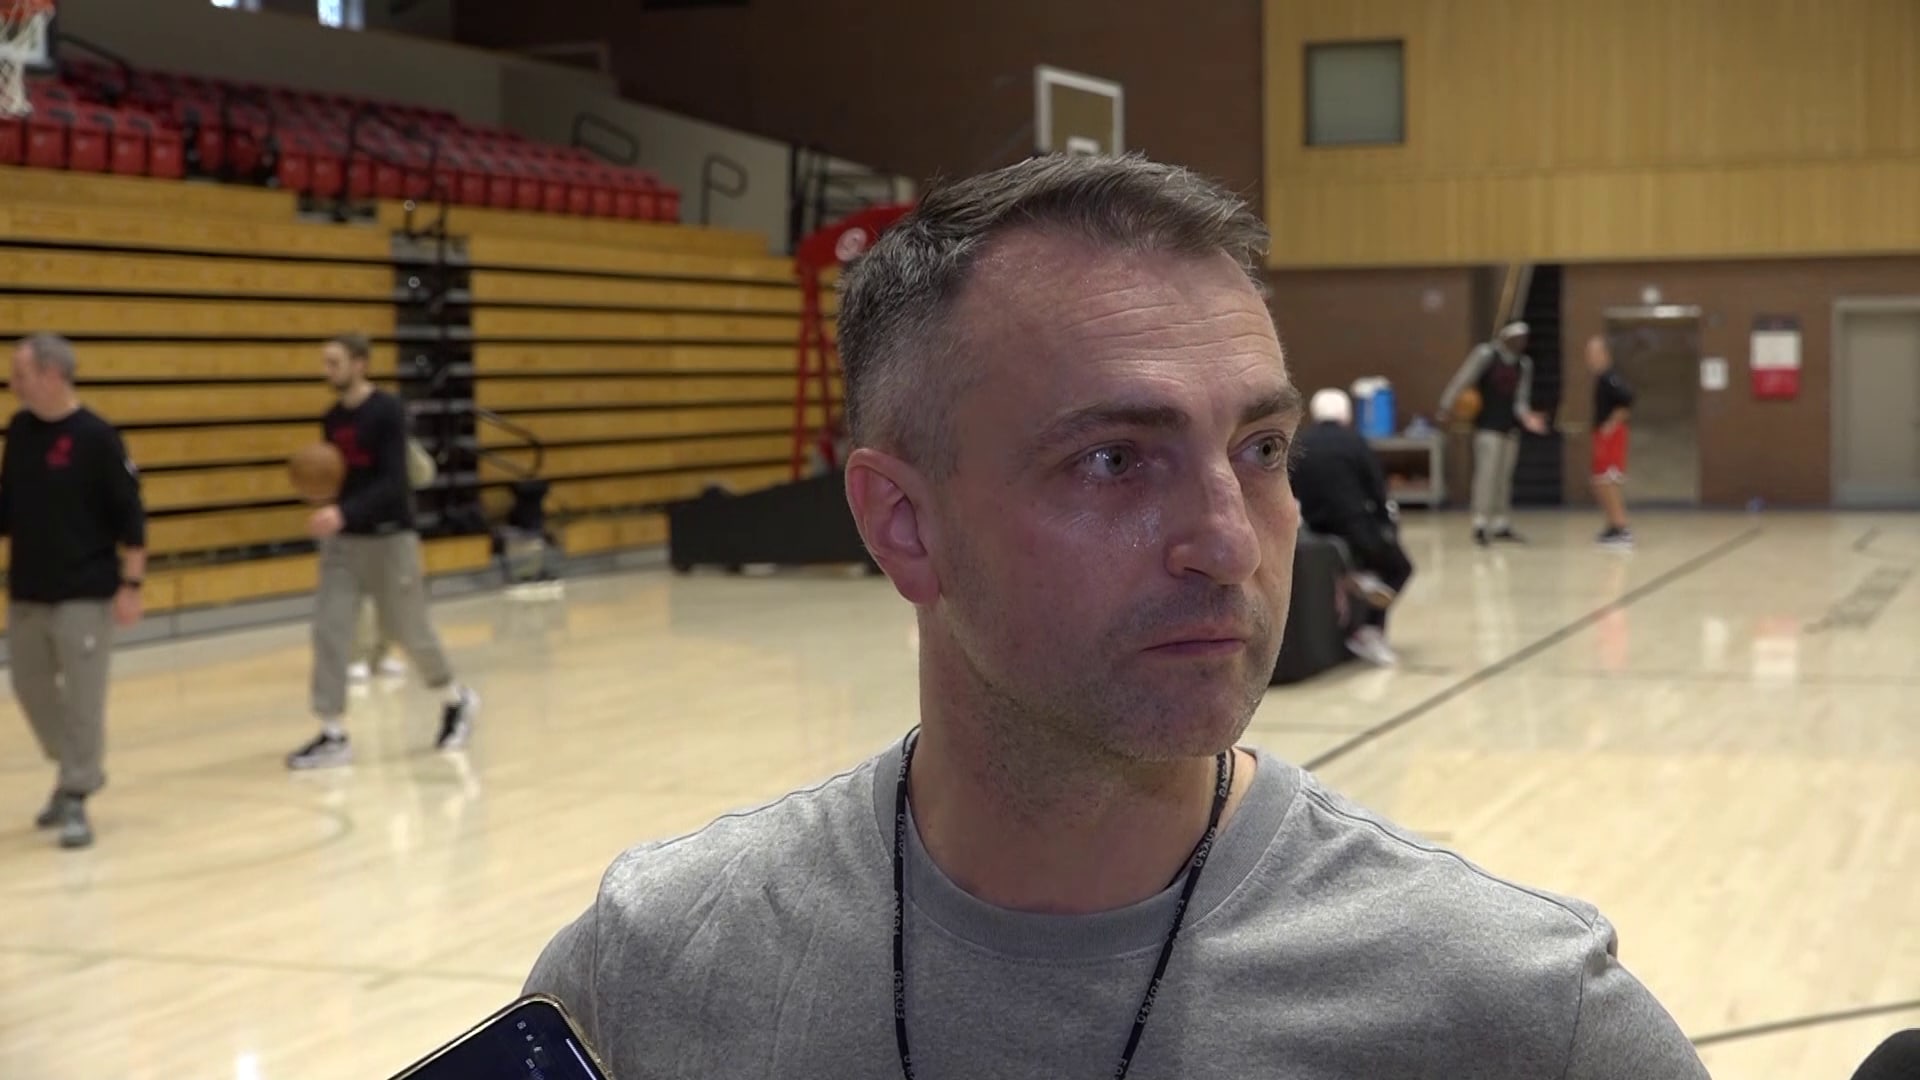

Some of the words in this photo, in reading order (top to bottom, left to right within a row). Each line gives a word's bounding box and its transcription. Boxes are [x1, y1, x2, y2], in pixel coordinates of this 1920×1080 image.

[1194, 827, 1216, 867] FOX40
[893, 970, 905, 1019] FOX40
[1136, 978, 1162, 1024] FOX40
